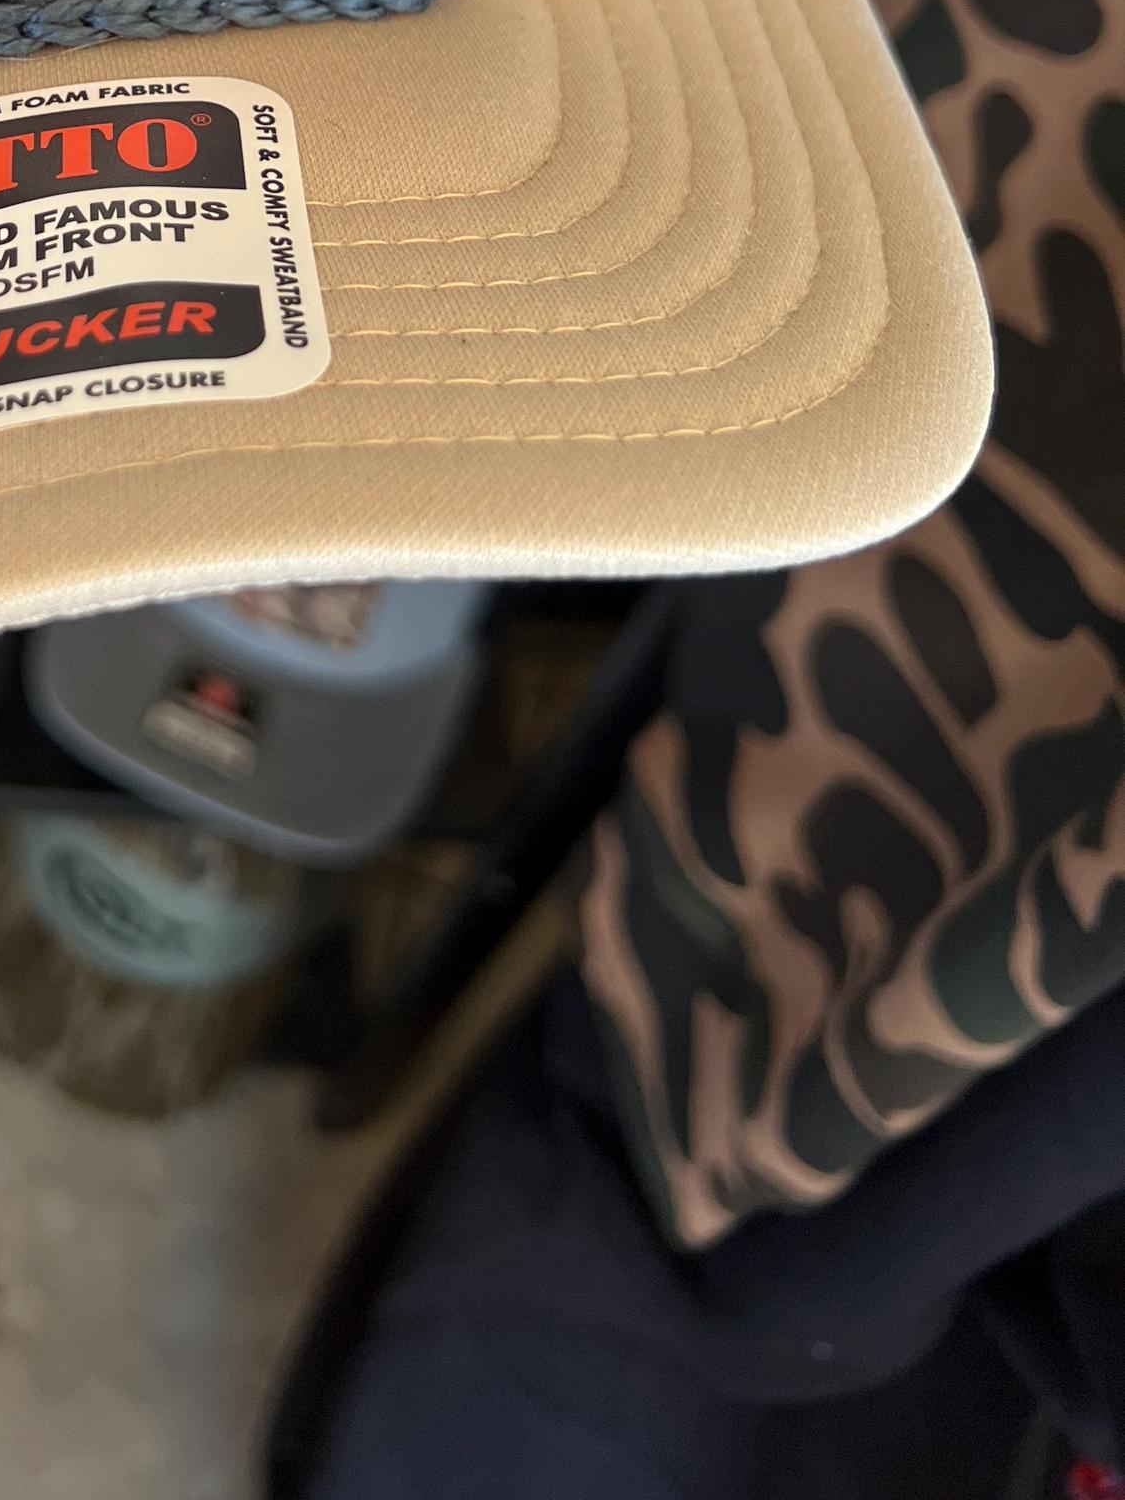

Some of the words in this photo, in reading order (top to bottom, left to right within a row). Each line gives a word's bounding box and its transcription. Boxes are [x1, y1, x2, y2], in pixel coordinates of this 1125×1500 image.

[11, 90, 89, 111] FOAM
[98, 82, 191, 99] FABRIC
[252, 104, 279, 144] SOFT
[258, 148, 281, 162] &
[34, 199, 230, 236] FAMOUS
[261, 168, 292, 232] COMFY
[34, 222, 195, 263] FRONT
[269, 236, 309, 349] SWEATBAND
[84, 370, 226, 398] CLOSURE
